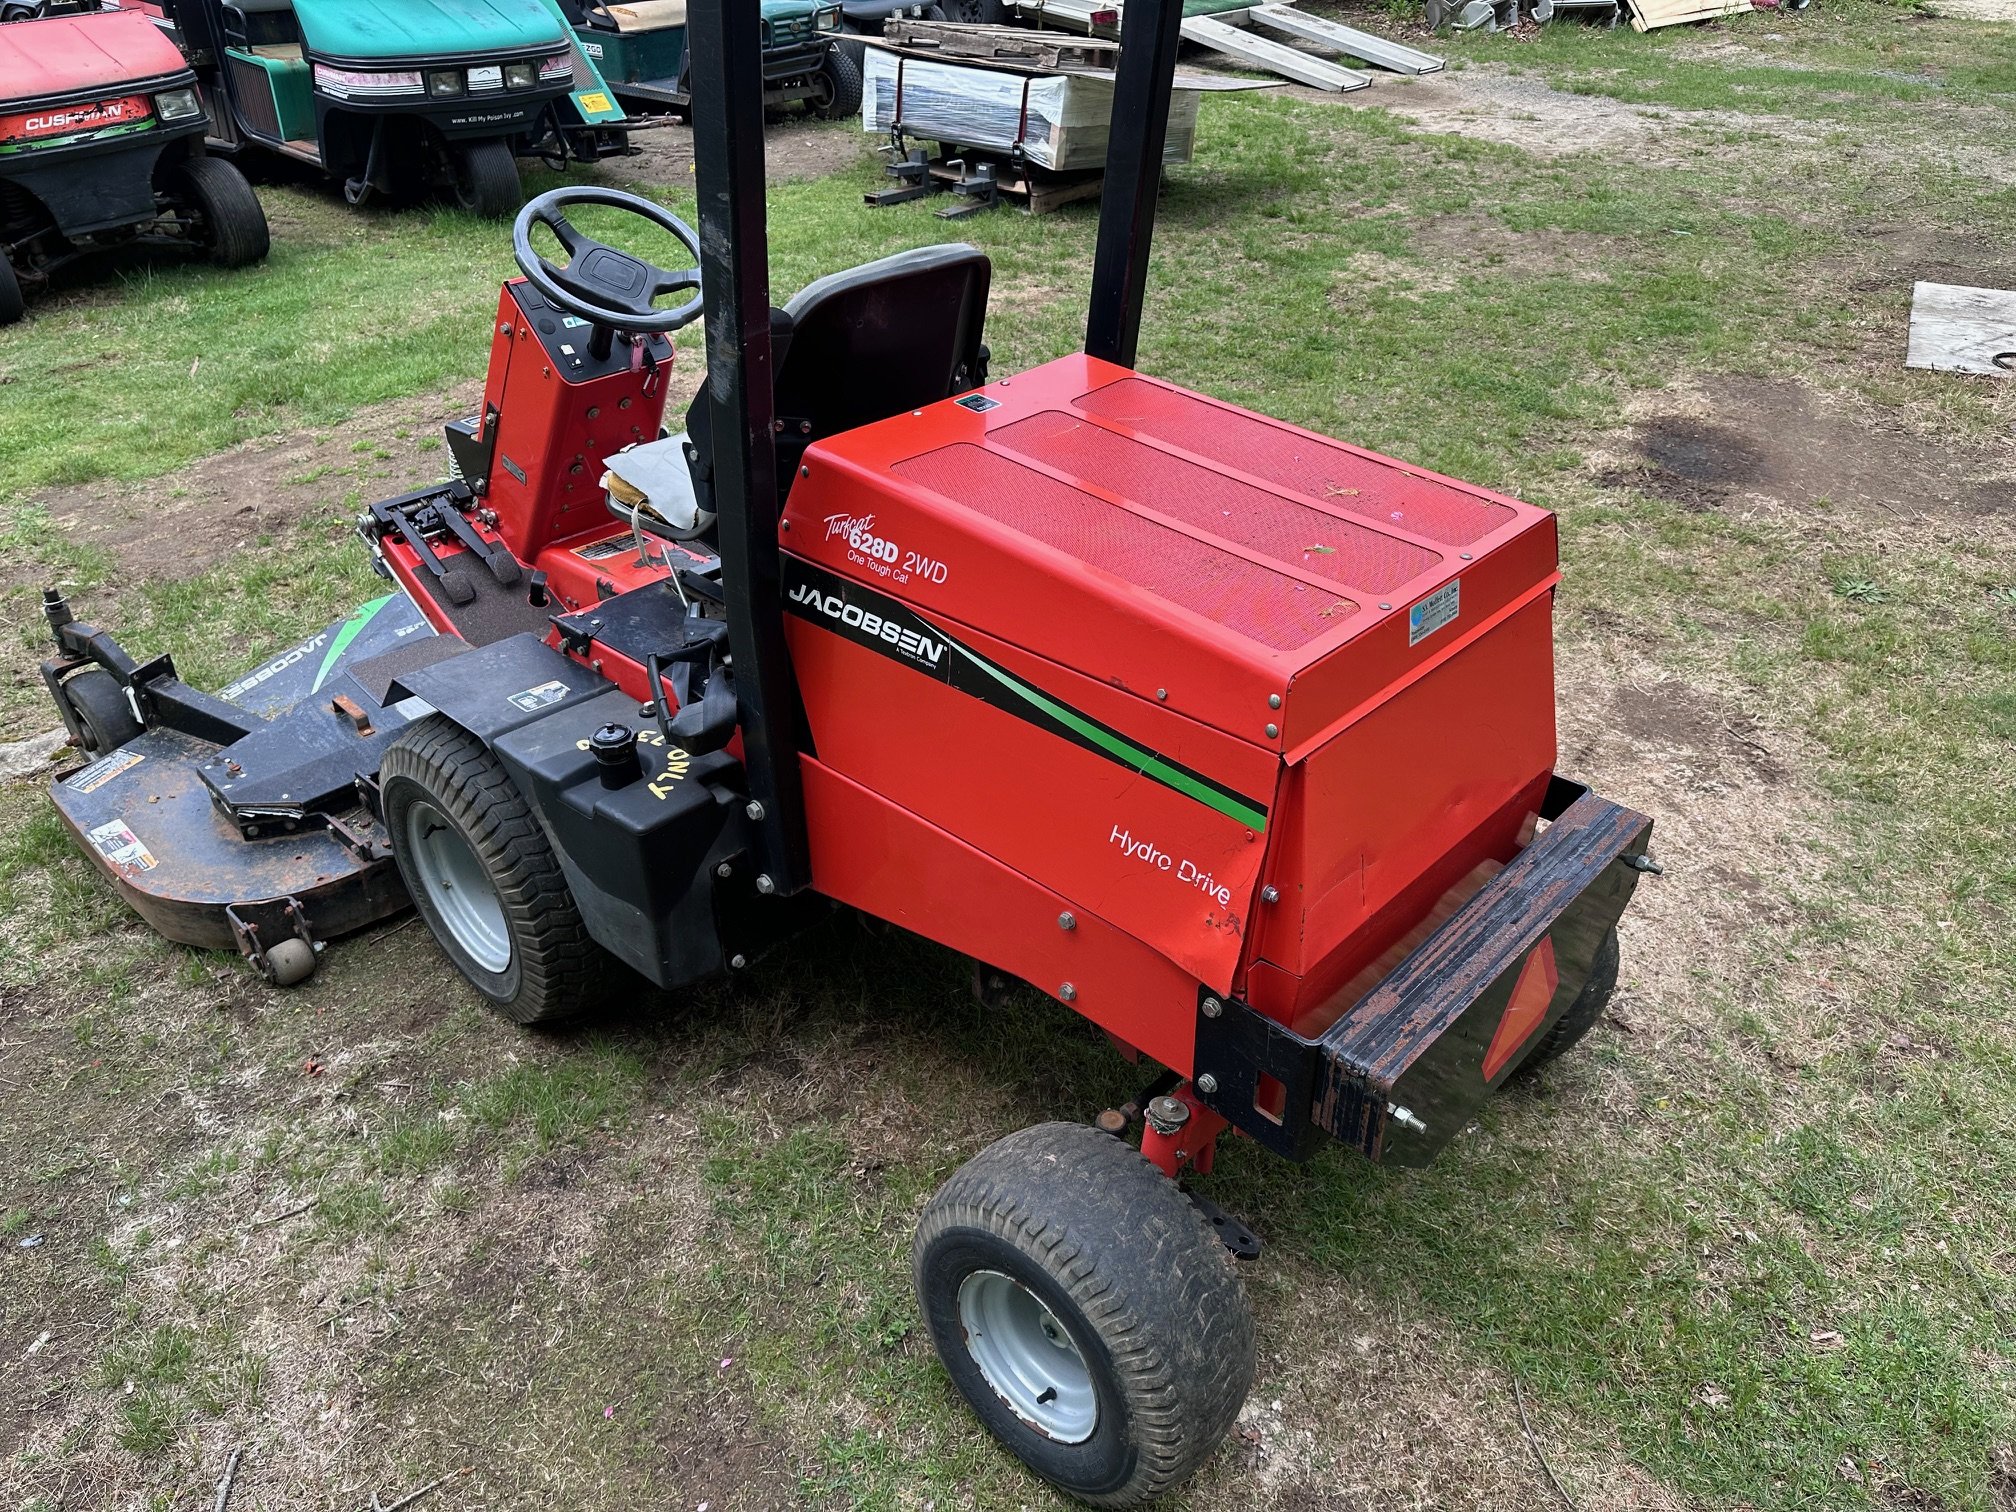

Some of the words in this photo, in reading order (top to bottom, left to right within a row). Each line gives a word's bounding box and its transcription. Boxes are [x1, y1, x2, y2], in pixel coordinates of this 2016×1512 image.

[582, 44, 601, 53] ZGO
[823, 513, 875, 542] Turfcat
[847, 549, 865, 566] One
[866, 557, 891, 577] Tough
[892, 569, 909, 585] Cat
[849, 527, 899, 563] 628D
[902, 551, 948, 584] 2WD
[789, 584, 943, 662] JACOBSEN
[916, 656, 937, 671] Company
[647, 748, 691, 800] ONLY
[1109, 824, 1172, 871] Hydro
[1176, 859, 1231, 911] Drive
